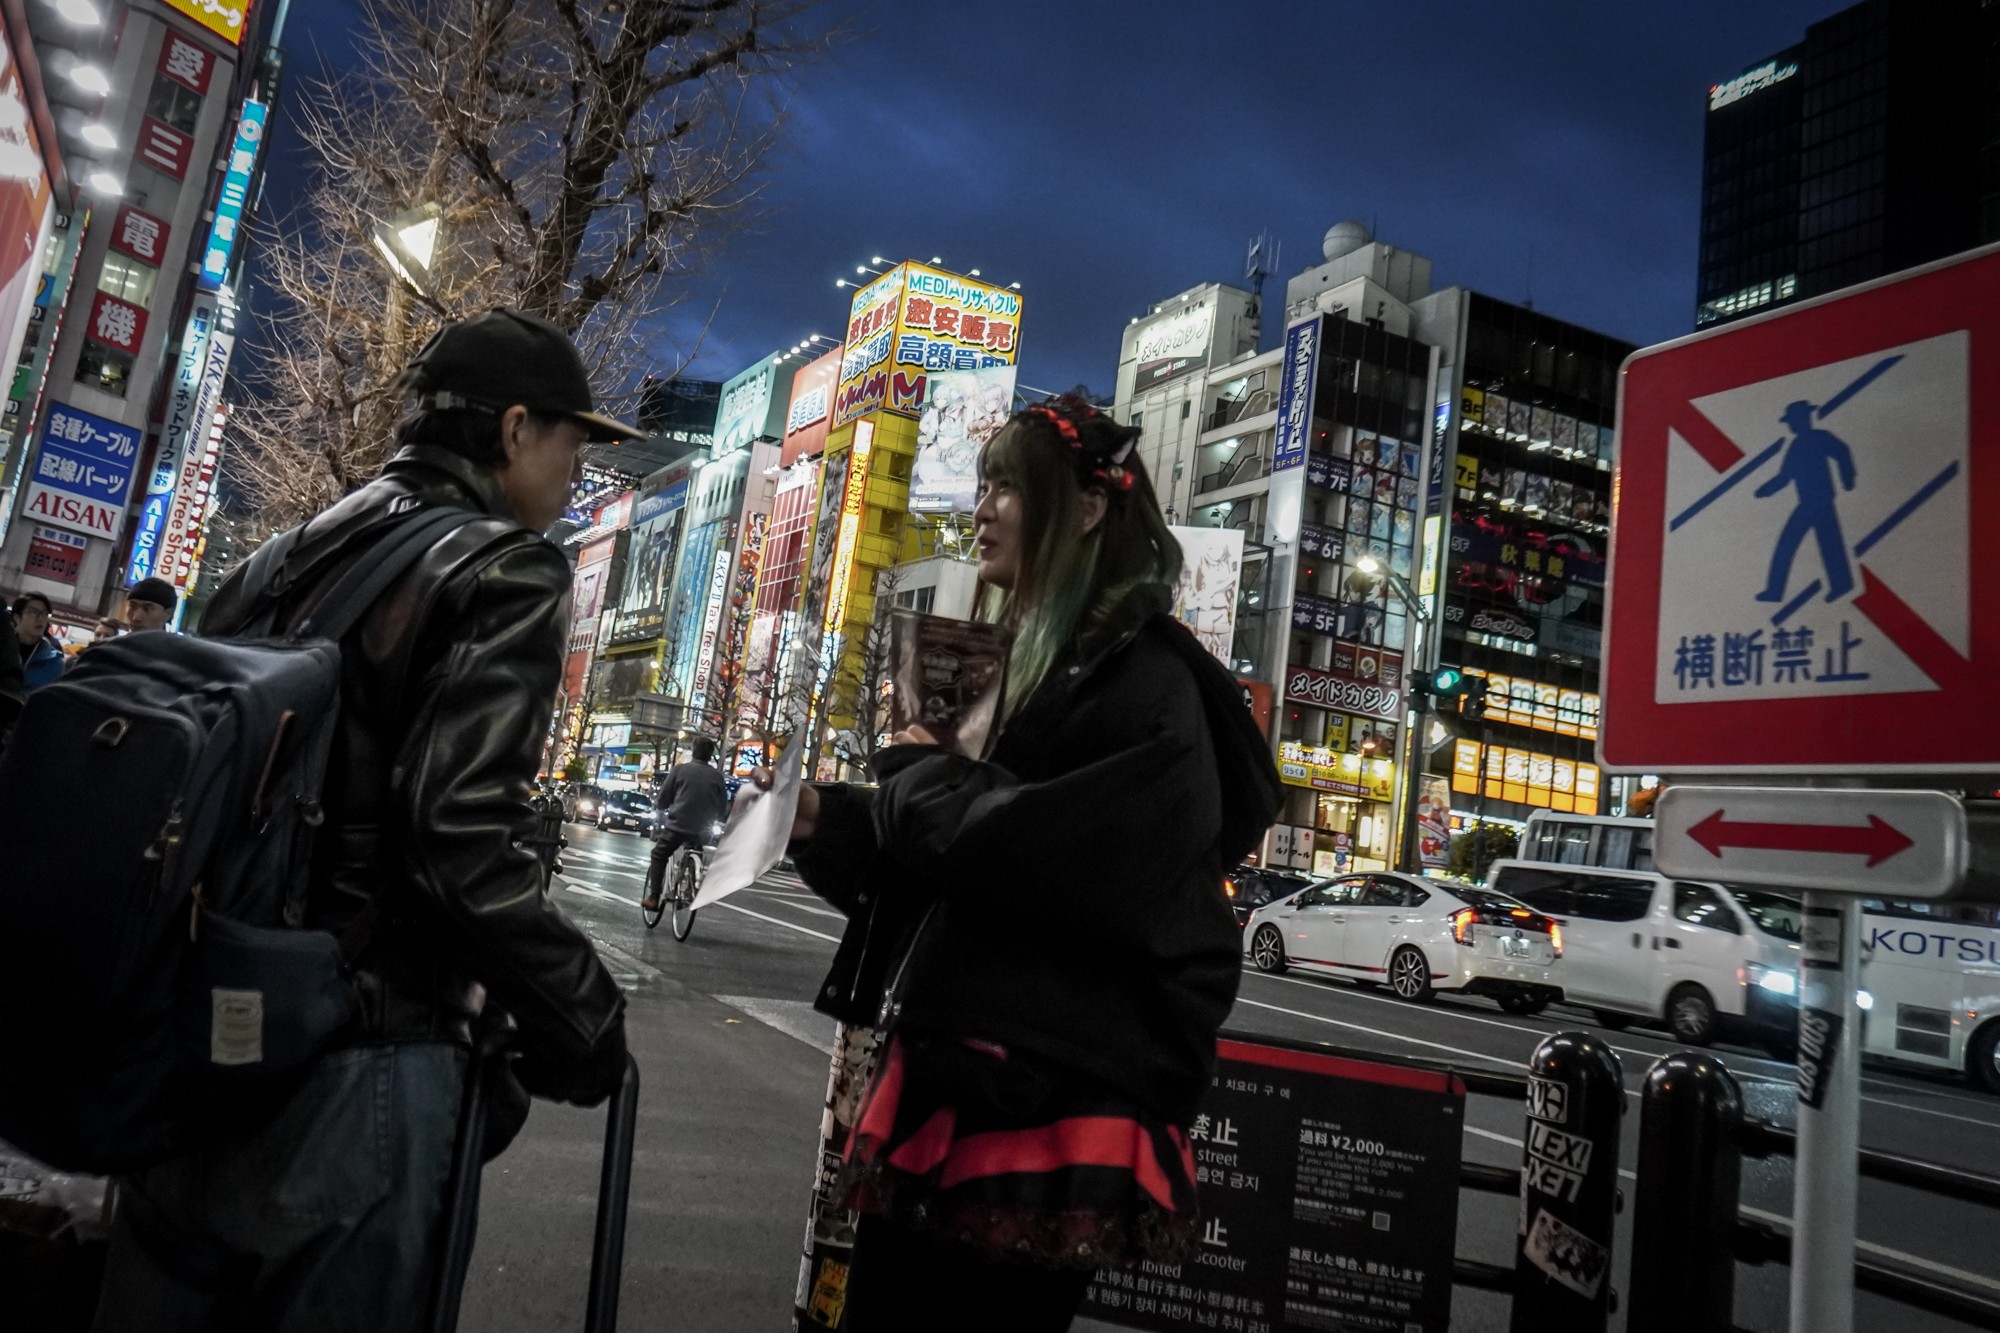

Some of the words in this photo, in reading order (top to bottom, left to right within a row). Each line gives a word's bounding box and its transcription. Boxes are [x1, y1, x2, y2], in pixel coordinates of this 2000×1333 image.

[908, 272, 1018, 315] MEDIAリサイクル
[905, 297, 1012, 349] 激安販売
[788, 386, 826, 432] SEGA
[50, 412, 134, 458] 各種ケーブル
[39, 452, 125, 495] 配線パーツ
[1330, 475, 1348, 491] 7F
[1457, 466, 1475, 483] 7F
[29, 491, 116, 532] AISAN
[171, 460, 201, 529] Tax-free
[130, 498, 163, 582] AISAN
[160, 532, 183, 575] Shop
[1321, 543, 1341, 560] 6F
[1451, 536, 1470, 552] 5F
[714, 553, 729, 590] AKKY
[1314, 614, 1335, 631] 5F
[1445, 606, 1464, 622] 5F
[1673, 621, 1871, 690] 横断禁止
[694, 657, 711, 694] Shop
[1290, 673, 1398, 715] メイドカジノ
[1226, 1079, 1258, 1094] 치요다
[1263, 1085, 1274, 1096] 구
[1189, 1114, 1238, 1147] 禁止
[1332, 1134, 1384, 1156] ¥2,000
[1197, 1148, 1238, 1167] street
[1196, 1166, 1224, 1185] 흡연
[1230, 1172, 1259, 1192] 금지
[1101, 1288, 1132, 1310] 원동기
[1136, 1297, 1157, 1315] 장치
[1160, 1302, 1193, 1323] 자전거
[1195, 1309, 1218, 1328] 노상
[1221, 1313, 1244, 1333] 주차
